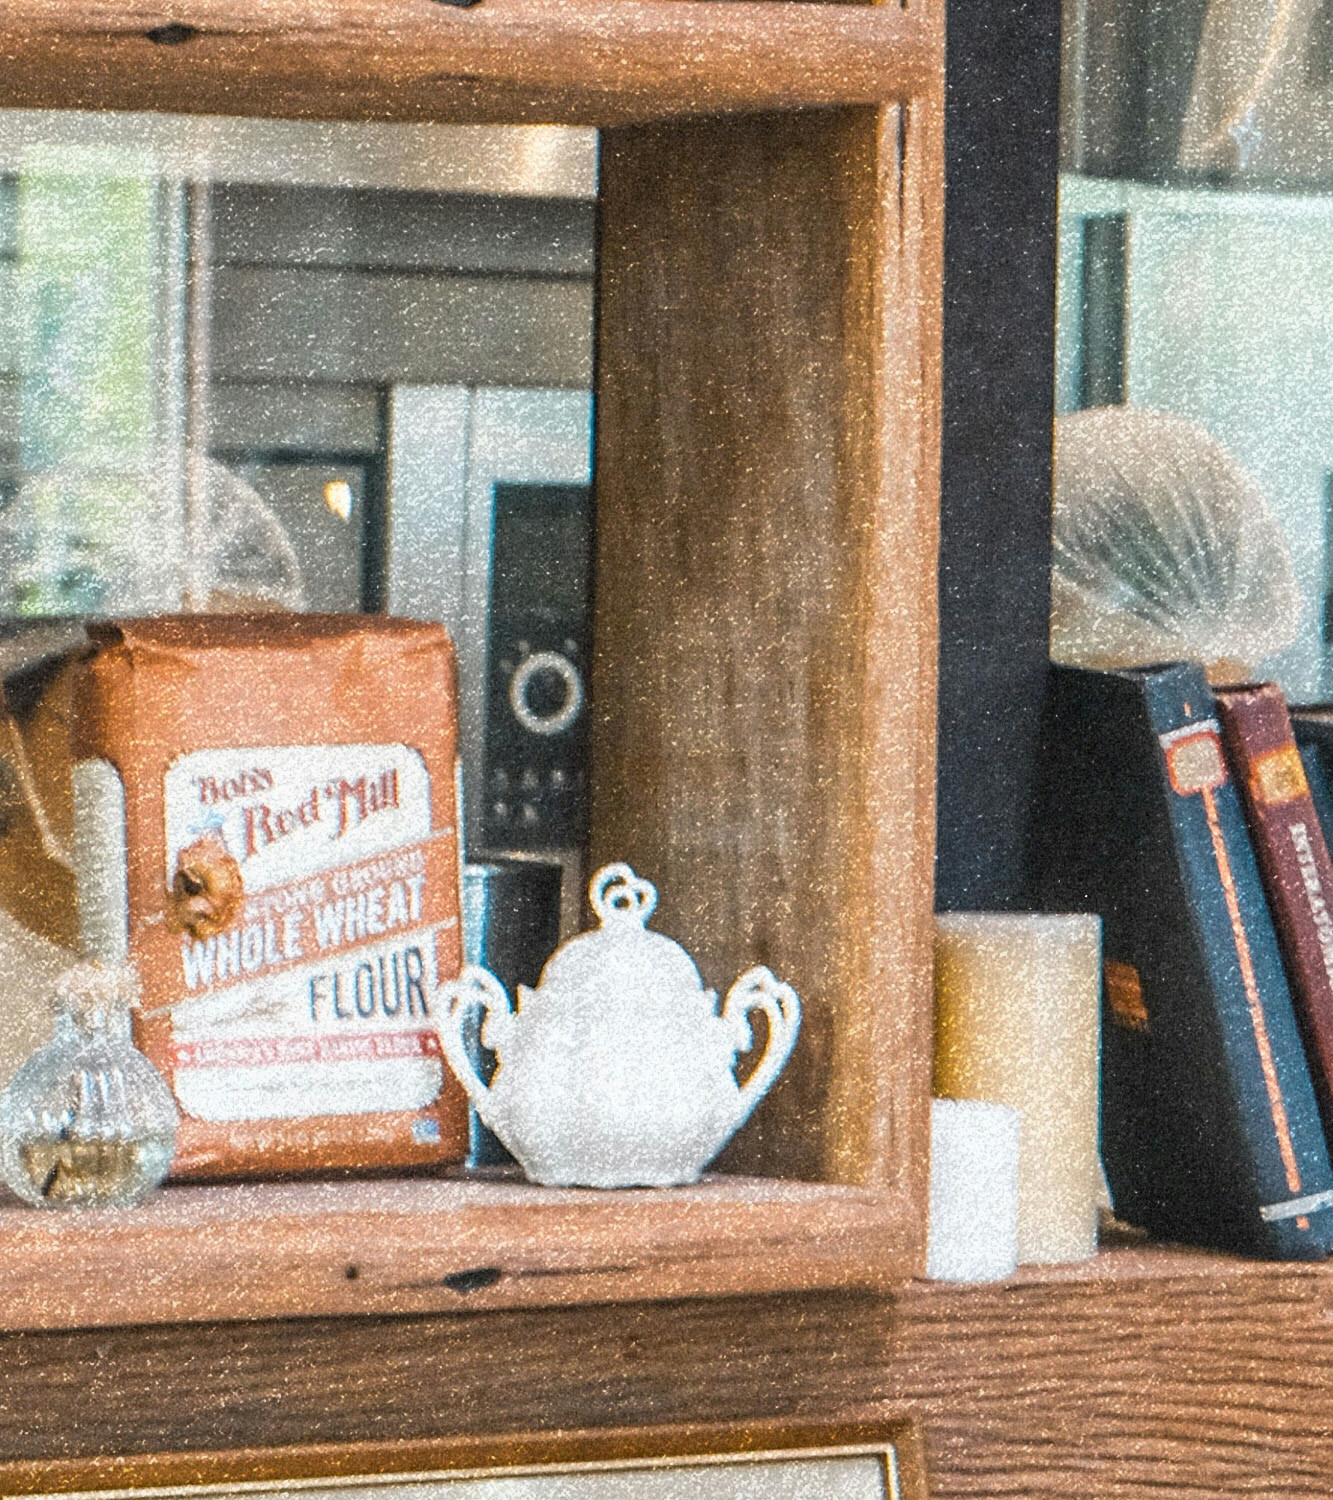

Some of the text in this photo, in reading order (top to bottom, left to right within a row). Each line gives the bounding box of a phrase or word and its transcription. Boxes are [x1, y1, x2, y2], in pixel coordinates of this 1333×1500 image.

[242, 769, 400, 856] Red Mill
[181, 876, 425, 989] WHOLE WHEAT
[308, 946, 430, 1020] FLOUR
